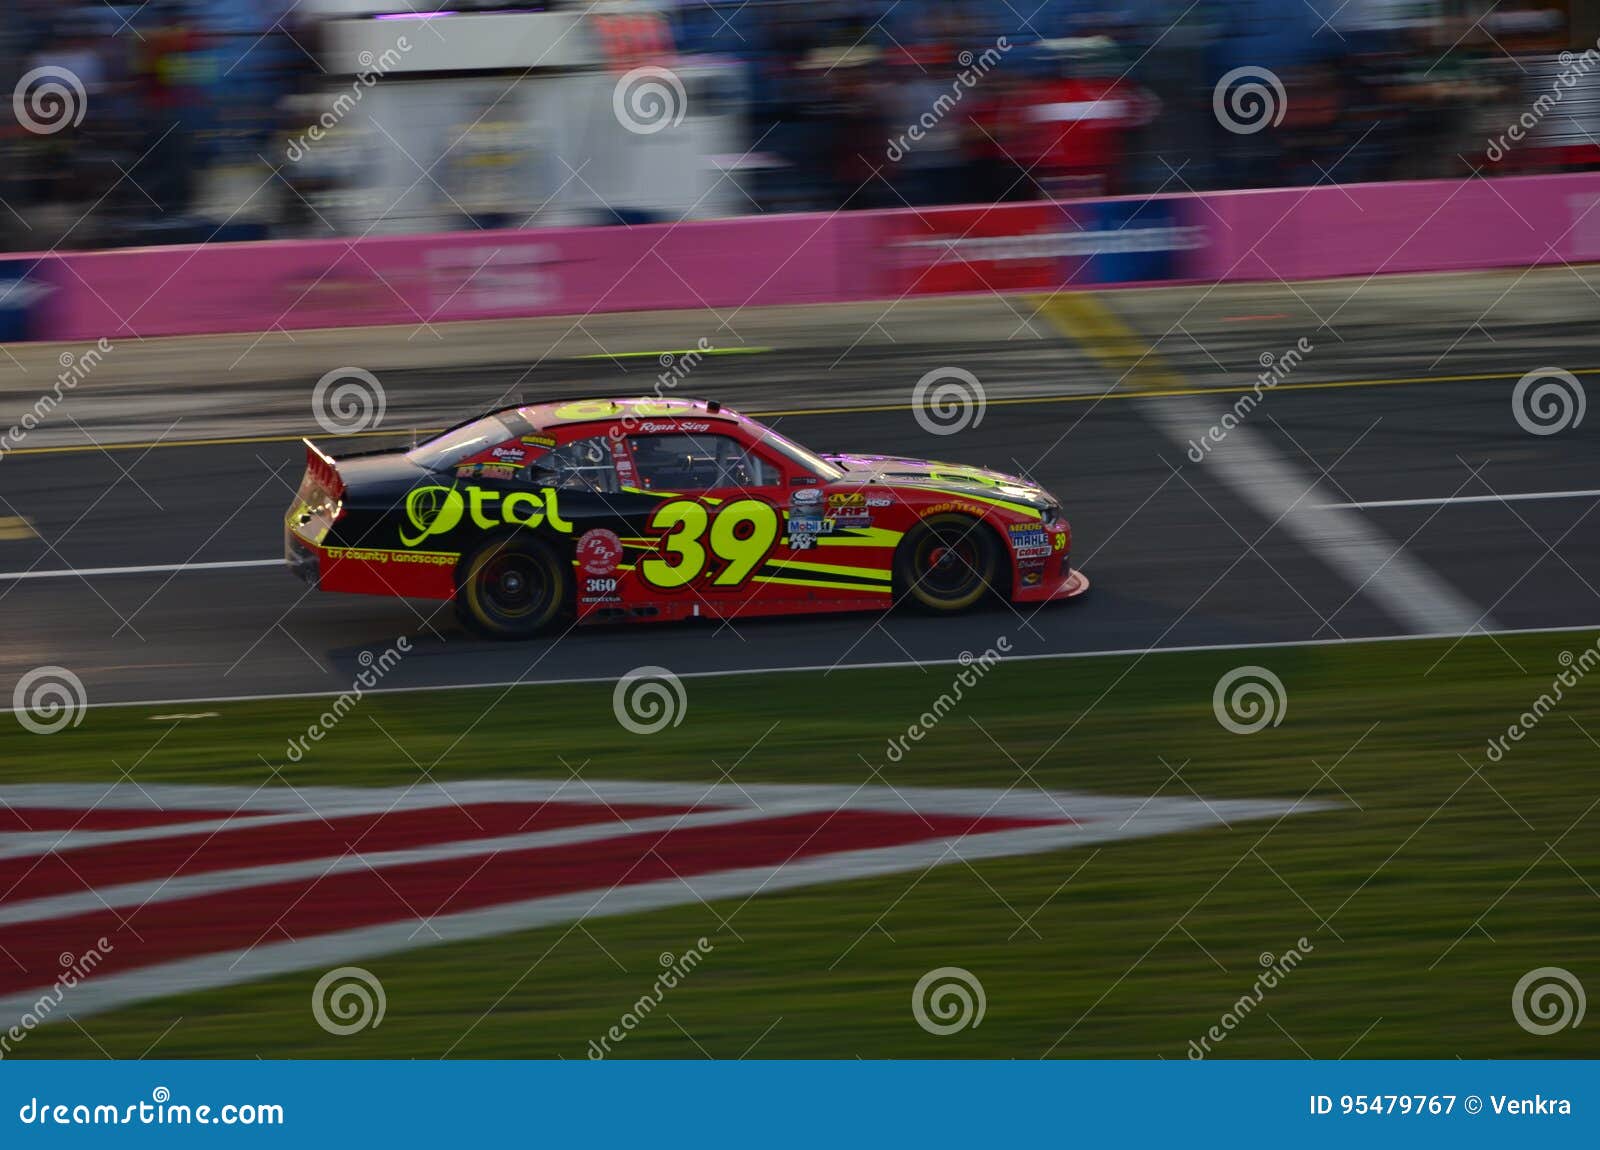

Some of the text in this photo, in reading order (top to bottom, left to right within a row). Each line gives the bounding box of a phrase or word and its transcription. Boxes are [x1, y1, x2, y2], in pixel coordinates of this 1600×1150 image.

[641, 500, 777, 588] 39
[1054, 532, 1067, 550] 39
[586, 578, 617, 592] 360
